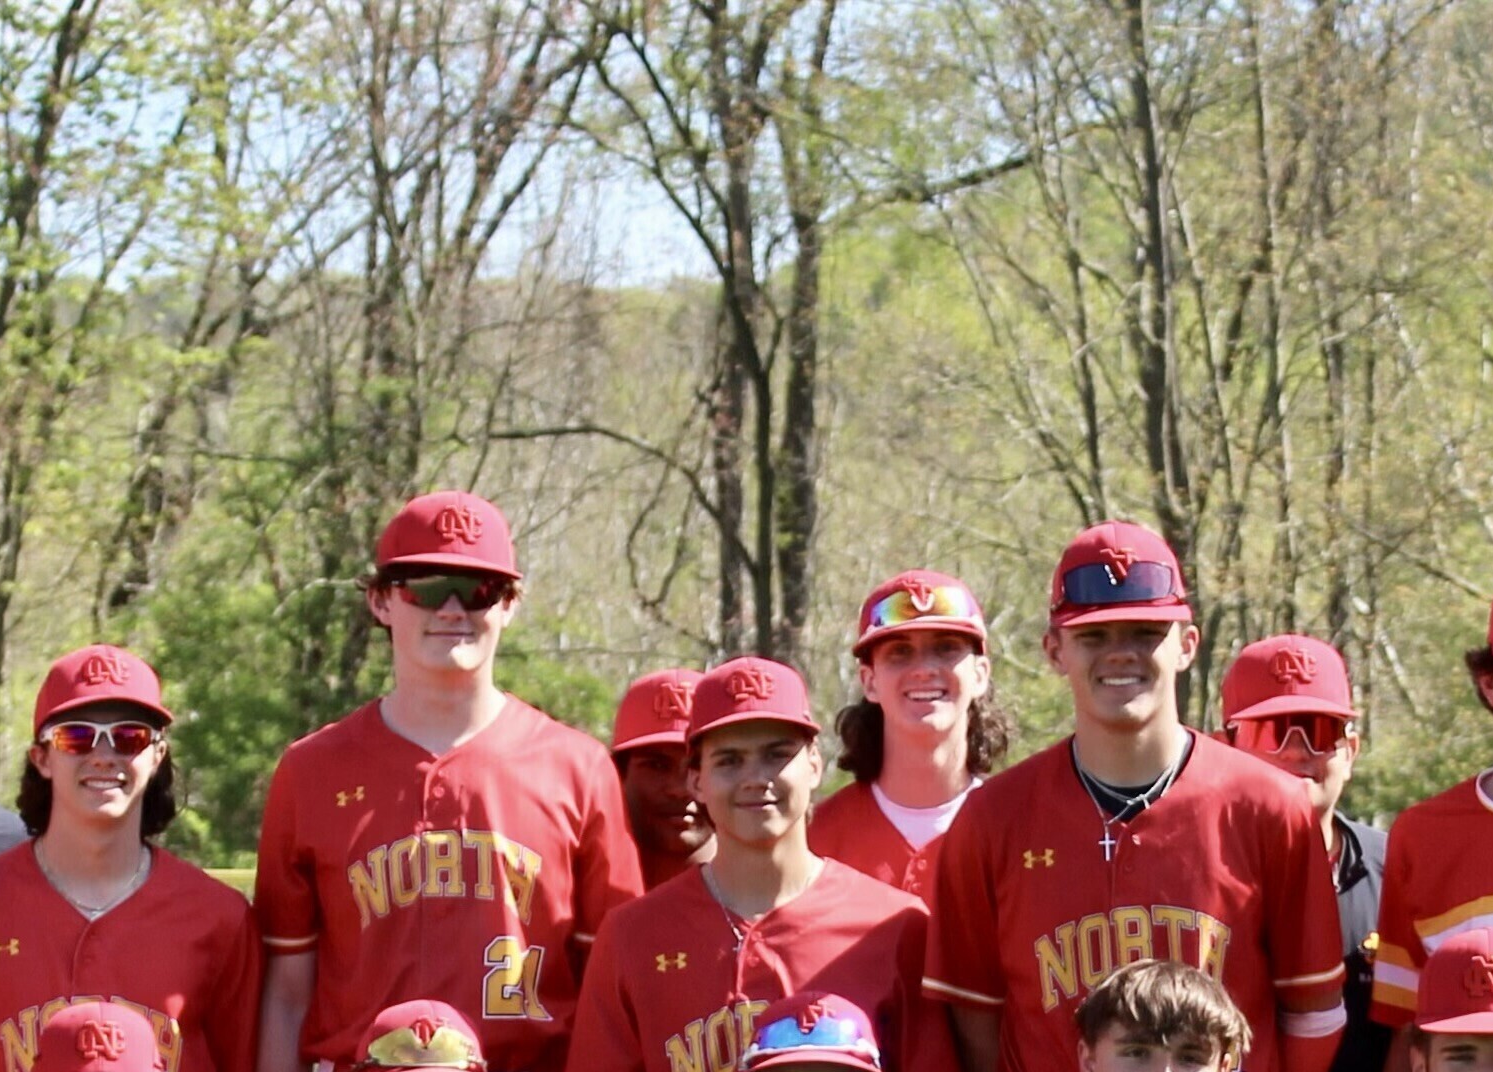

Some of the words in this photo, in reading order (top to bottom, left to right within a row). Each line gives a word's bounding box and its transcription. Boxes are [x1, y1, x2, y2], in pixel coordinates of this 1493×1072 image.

[348, 829, 542, 933] NORTH
[482, 935, 553, 1021] 21
[1034, 905, 1231, 1014] NORTH
